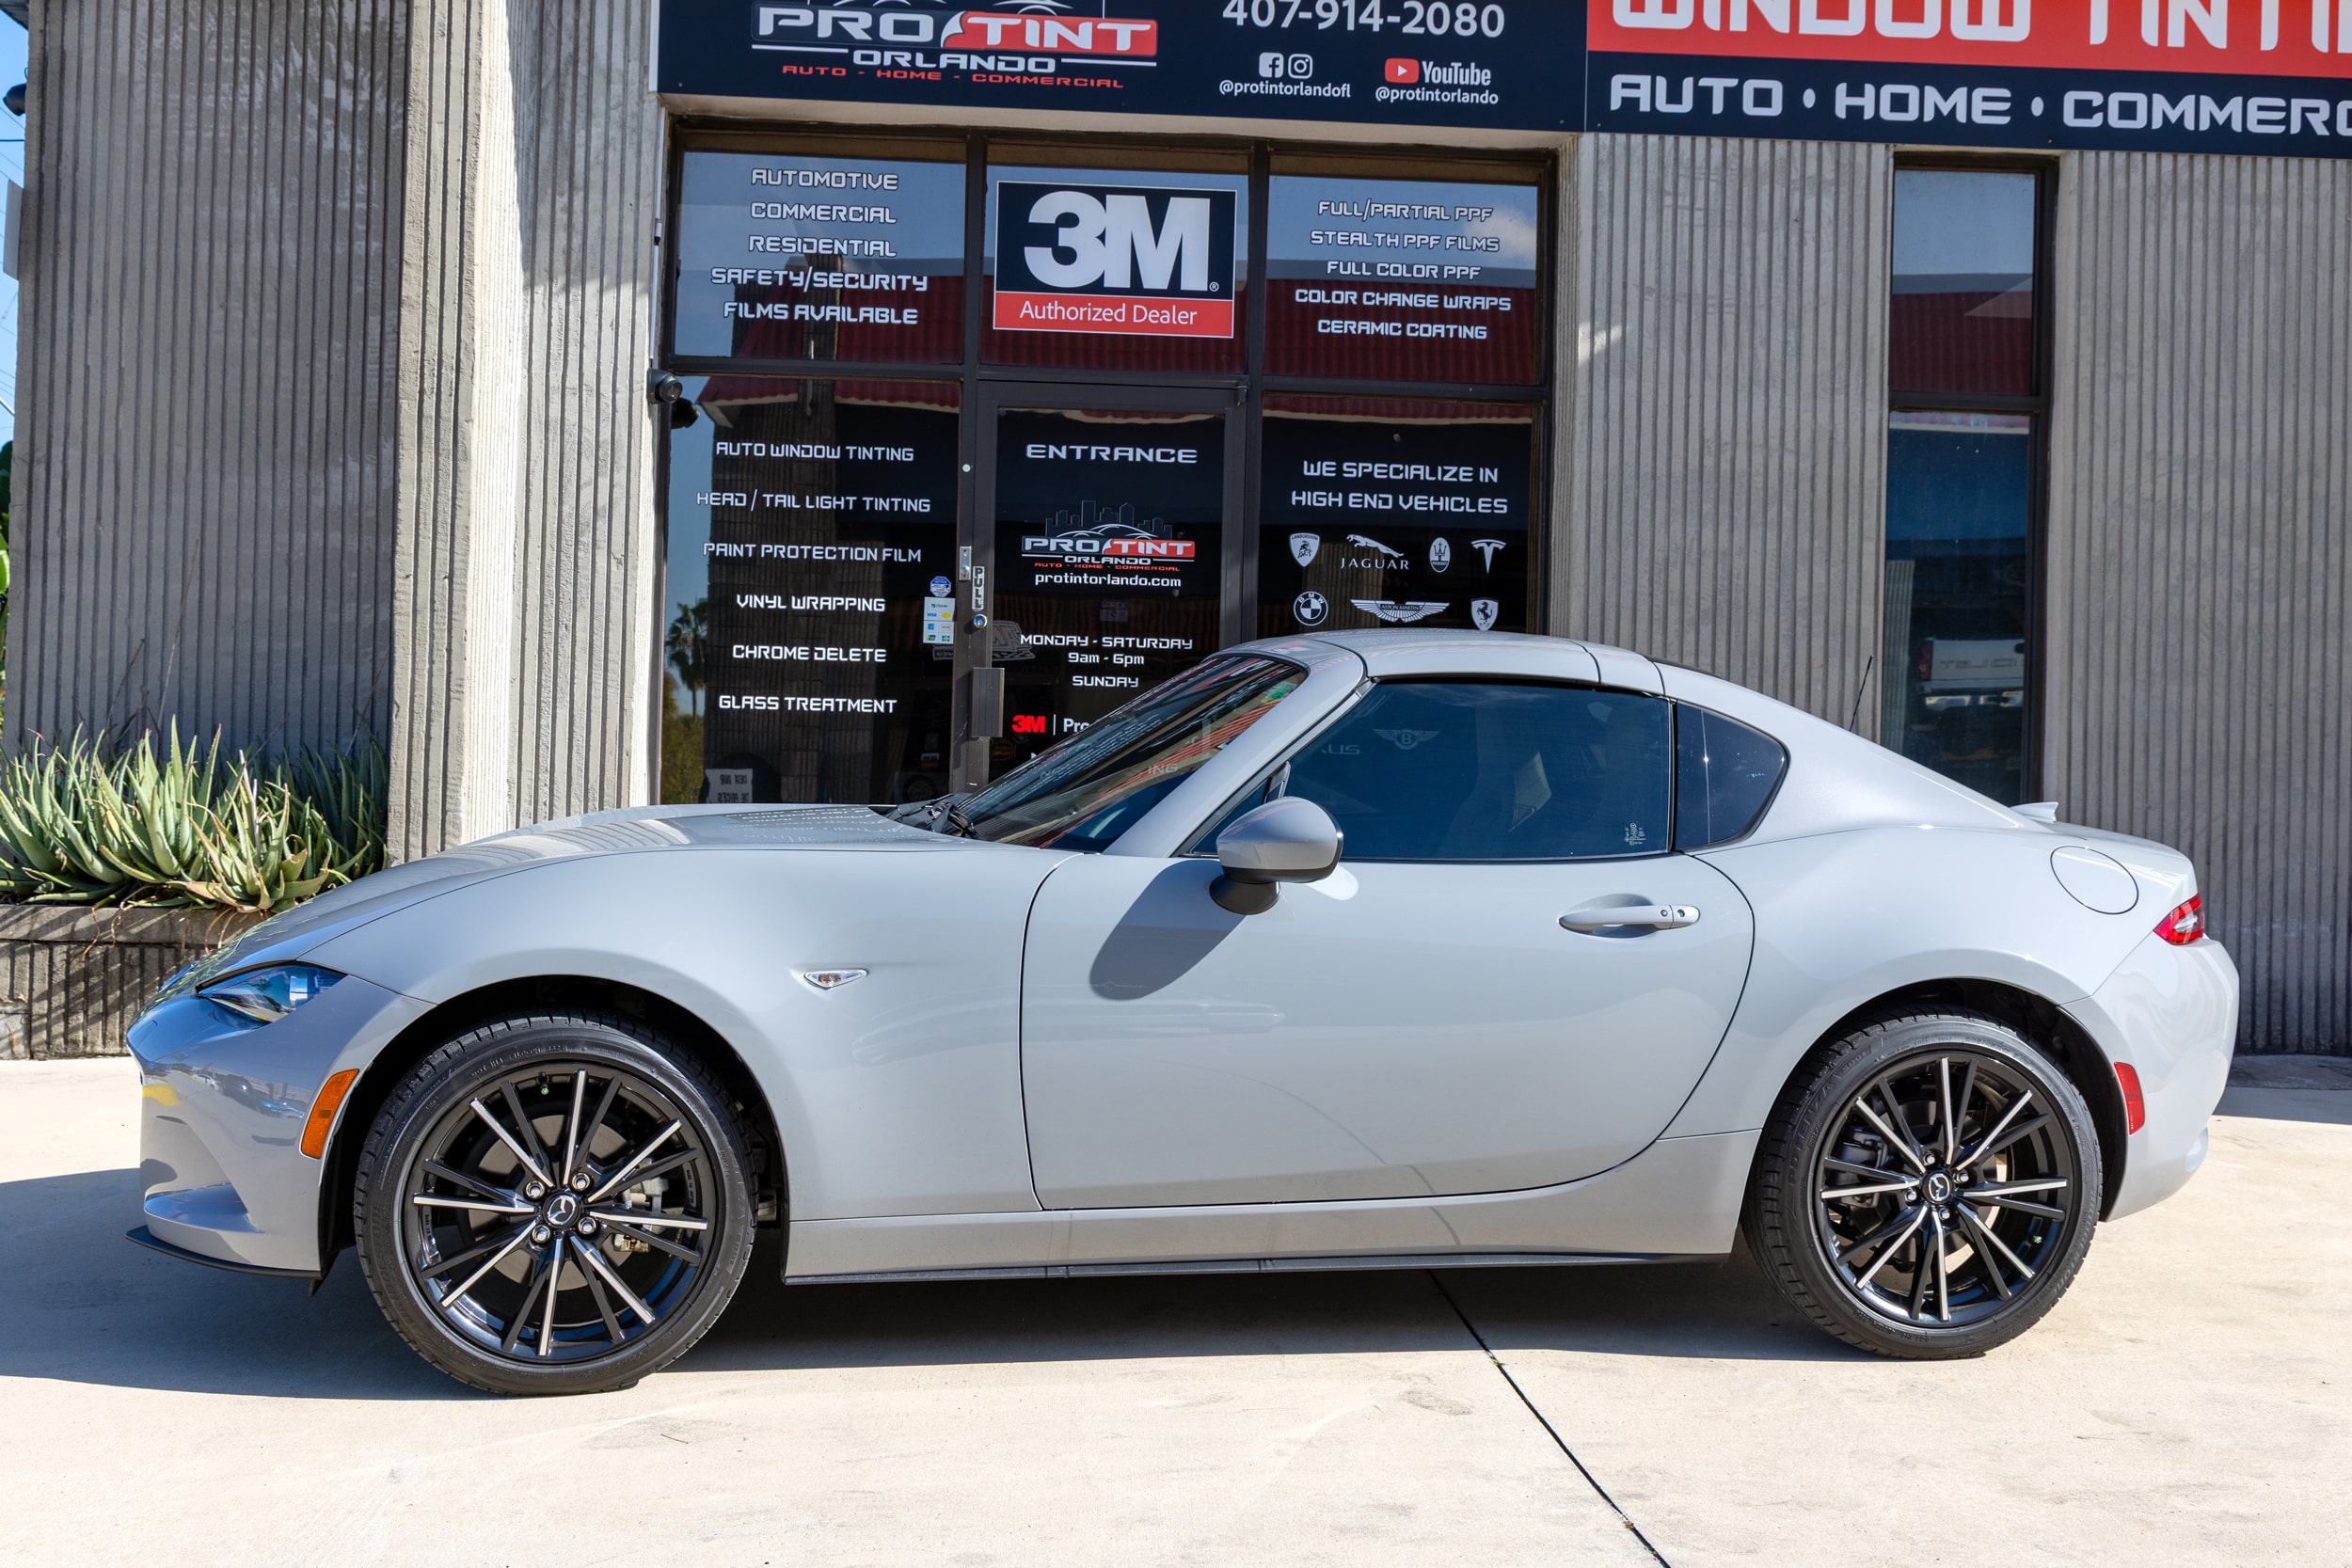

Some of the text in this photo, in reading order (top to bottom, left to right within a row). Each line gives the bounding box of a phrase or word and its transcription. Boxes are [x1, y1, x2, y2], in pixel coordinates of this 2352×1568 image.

[758, 8, 1152, 52] PRO TINT
[1221, 0, 1505, 38] 407-914-2080
[852, 49, 1057, 74] ORLANDO
[782, 65, 847, 77] AUTO
[876, 70, 942, 82] HOME
[972, 73, 1124, 89] COMMERCIAL
[1422, 60, 1492, 87] YouTube
[1218, 79, 1351, 99] @protintorlandofl
[1375, 86, 1500, 105] @protintorlando
[1610, 73, 1784, 117] AUTO
[1835, 82, 2011, 124] HOME
[751, 167, 899, 191] AUTOMOTIVE
[750, 201, 898, 225] COMMERCIAL
[1317, 198, 1494, 222] FULL/PARTIAL PPF
[748, 234, 898, 258] RESIDENTIAL
[1024, 190, 1211, 292] 3M
[1310, 229, 1501, 253] STEALTH PPF FILMS
[710, 265, 929, 293] SAFETY/SECURITY
[1327, 260, 1482, 281] FULL COLOR PPF
[1295, 288, 1512, 312] COLOR CHANGE WRAPS
[723, 301, 919, 325] FILMS AVAILABLE
[1019, 300, 1198, 325] Authorized Dealer
[1317, 319, 1488, 341] CERAMIC COATING
[715, 441, 914, 463] AUTO WINDOW TINTING
[1025, 443, 1199, 464] ENTRANCE
[1303, 460, 1499, 483] WE SPECIALIZE IN
[696, 491, 748, 507] HEAD
[762, 493, 802, 509] TAIL
[805, 495, 858, 511] LIGHT
[862, 497, 931, 513] TINTING
[1291, 490, 1508, 514] HIGH END VEHICLES
[703, 541, 922, 563] PAINT PROTECTION FILM
[1024, 537, 1193, 556] PRO TINT
[1064, 556, 1152, 565] ORLANDO
[1341, 557, 1410, 570] JAGUAR
[974, 567, 984, 609] PULL
[1034, 572, 1182, 588] protintorlando.com
[736, 594, 885, 612] VINYL WRAPPING
[732, 644, 887, 662] CHROME DELETE
[1020, 634, 1089, 647] MONDAY
[1102, 637, 1193, 650] SATURDAY
[1068, 653, 1100, 664] 9am
[1113, 654, 1145, 667] 6pm
[1072, 675, 1139, 689] SUNDAY
[718, 694, 898, 714] GLASS TREATMENT
[1011, 714, 1046, 734] 3M
